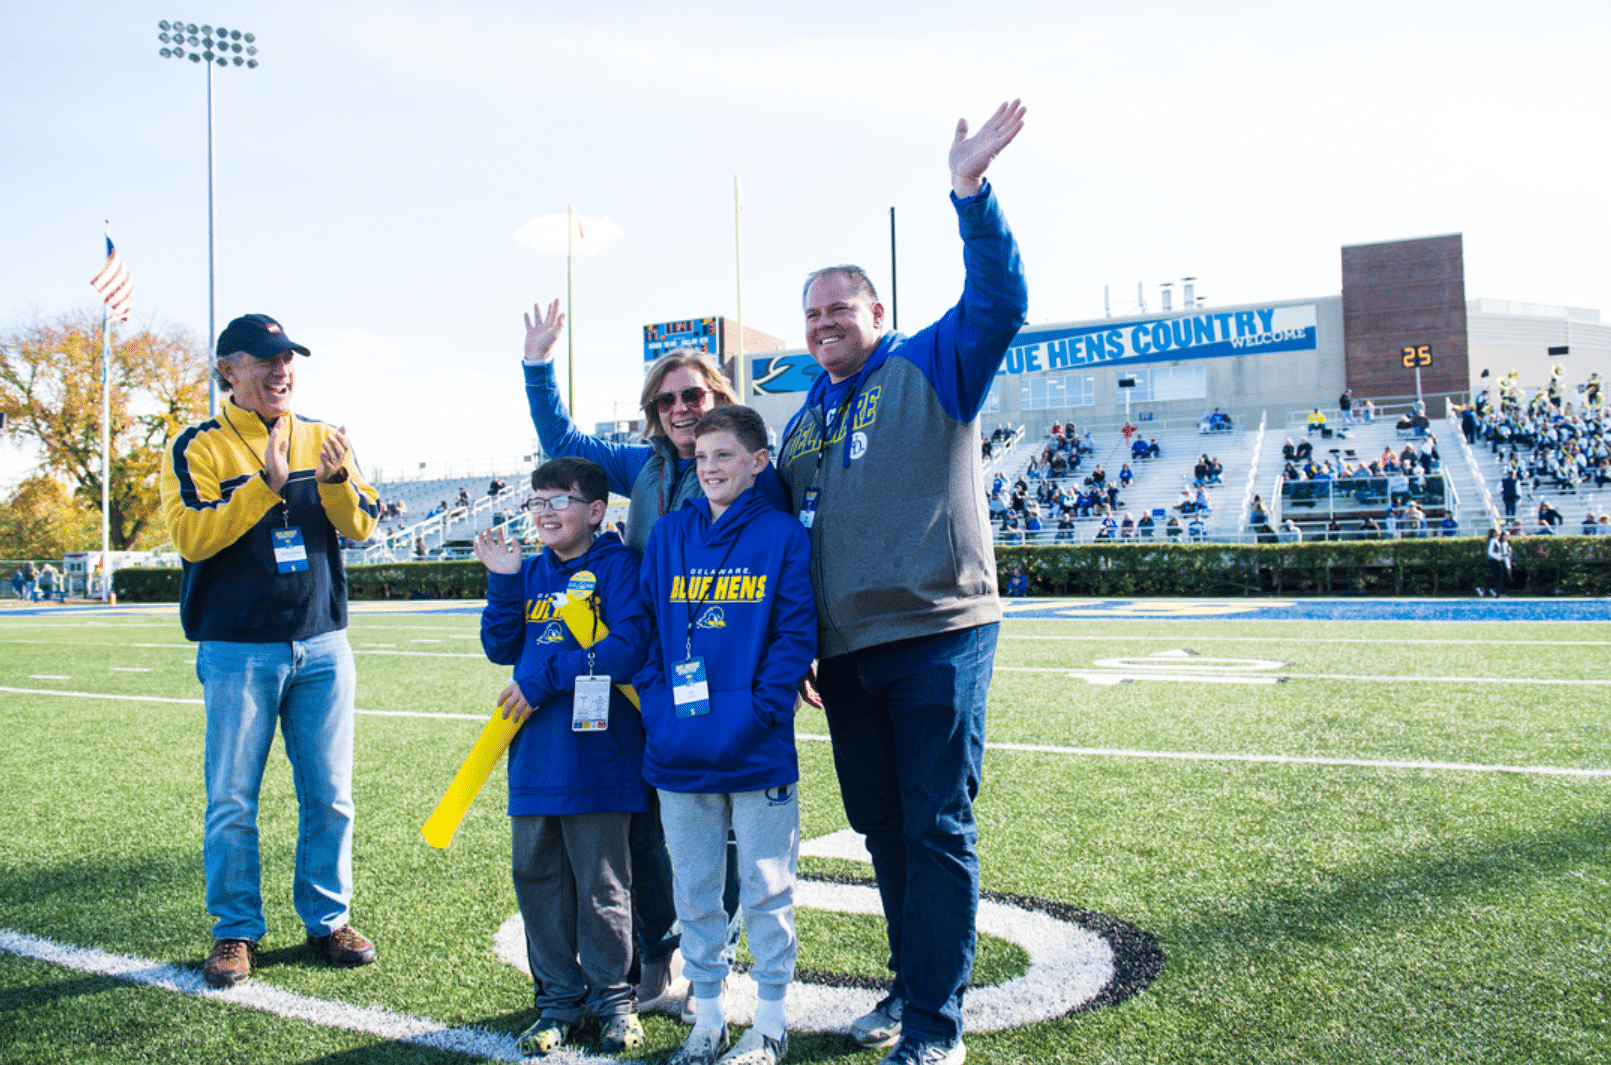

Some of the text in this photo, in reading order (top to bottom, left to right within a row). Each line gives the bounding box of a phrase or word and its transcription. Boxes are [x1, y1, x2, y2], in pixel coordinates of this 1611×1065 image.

[996, 309, 1275, 374] UE HENS COUNTRY
[1231, 328, 1306, 348] WELCOME
[1402, 345, 1432, 367] 25
[690, 567, 749, 575] DELAWARE
[670, 574, 768, 600] BLUE HENS
